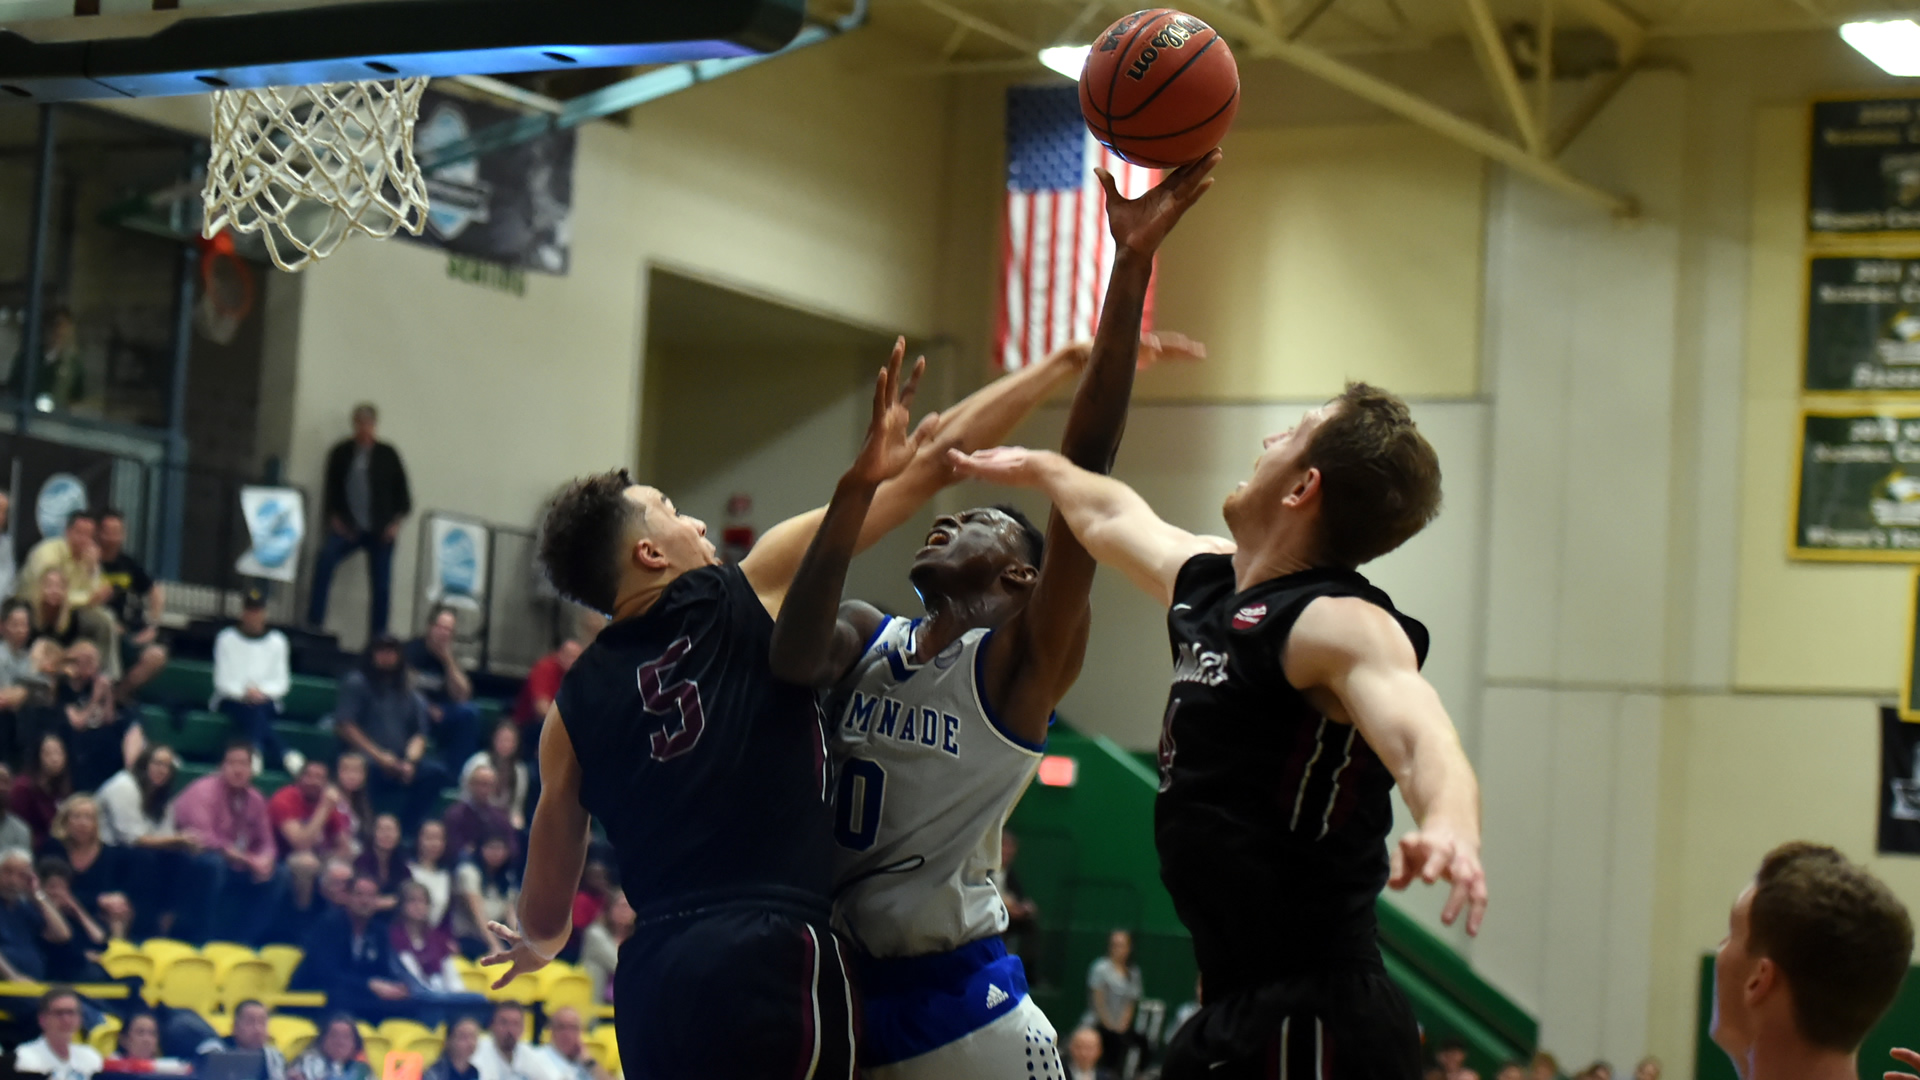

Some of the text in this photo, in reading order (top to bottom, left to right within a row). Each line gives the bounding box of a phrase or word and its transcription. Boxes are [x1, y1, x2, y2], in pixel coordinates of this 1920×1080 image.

[637, 635, 705, 762] 5
[832, 690, 962, 758] MNADE
[834, 757, 888, 852] 0
